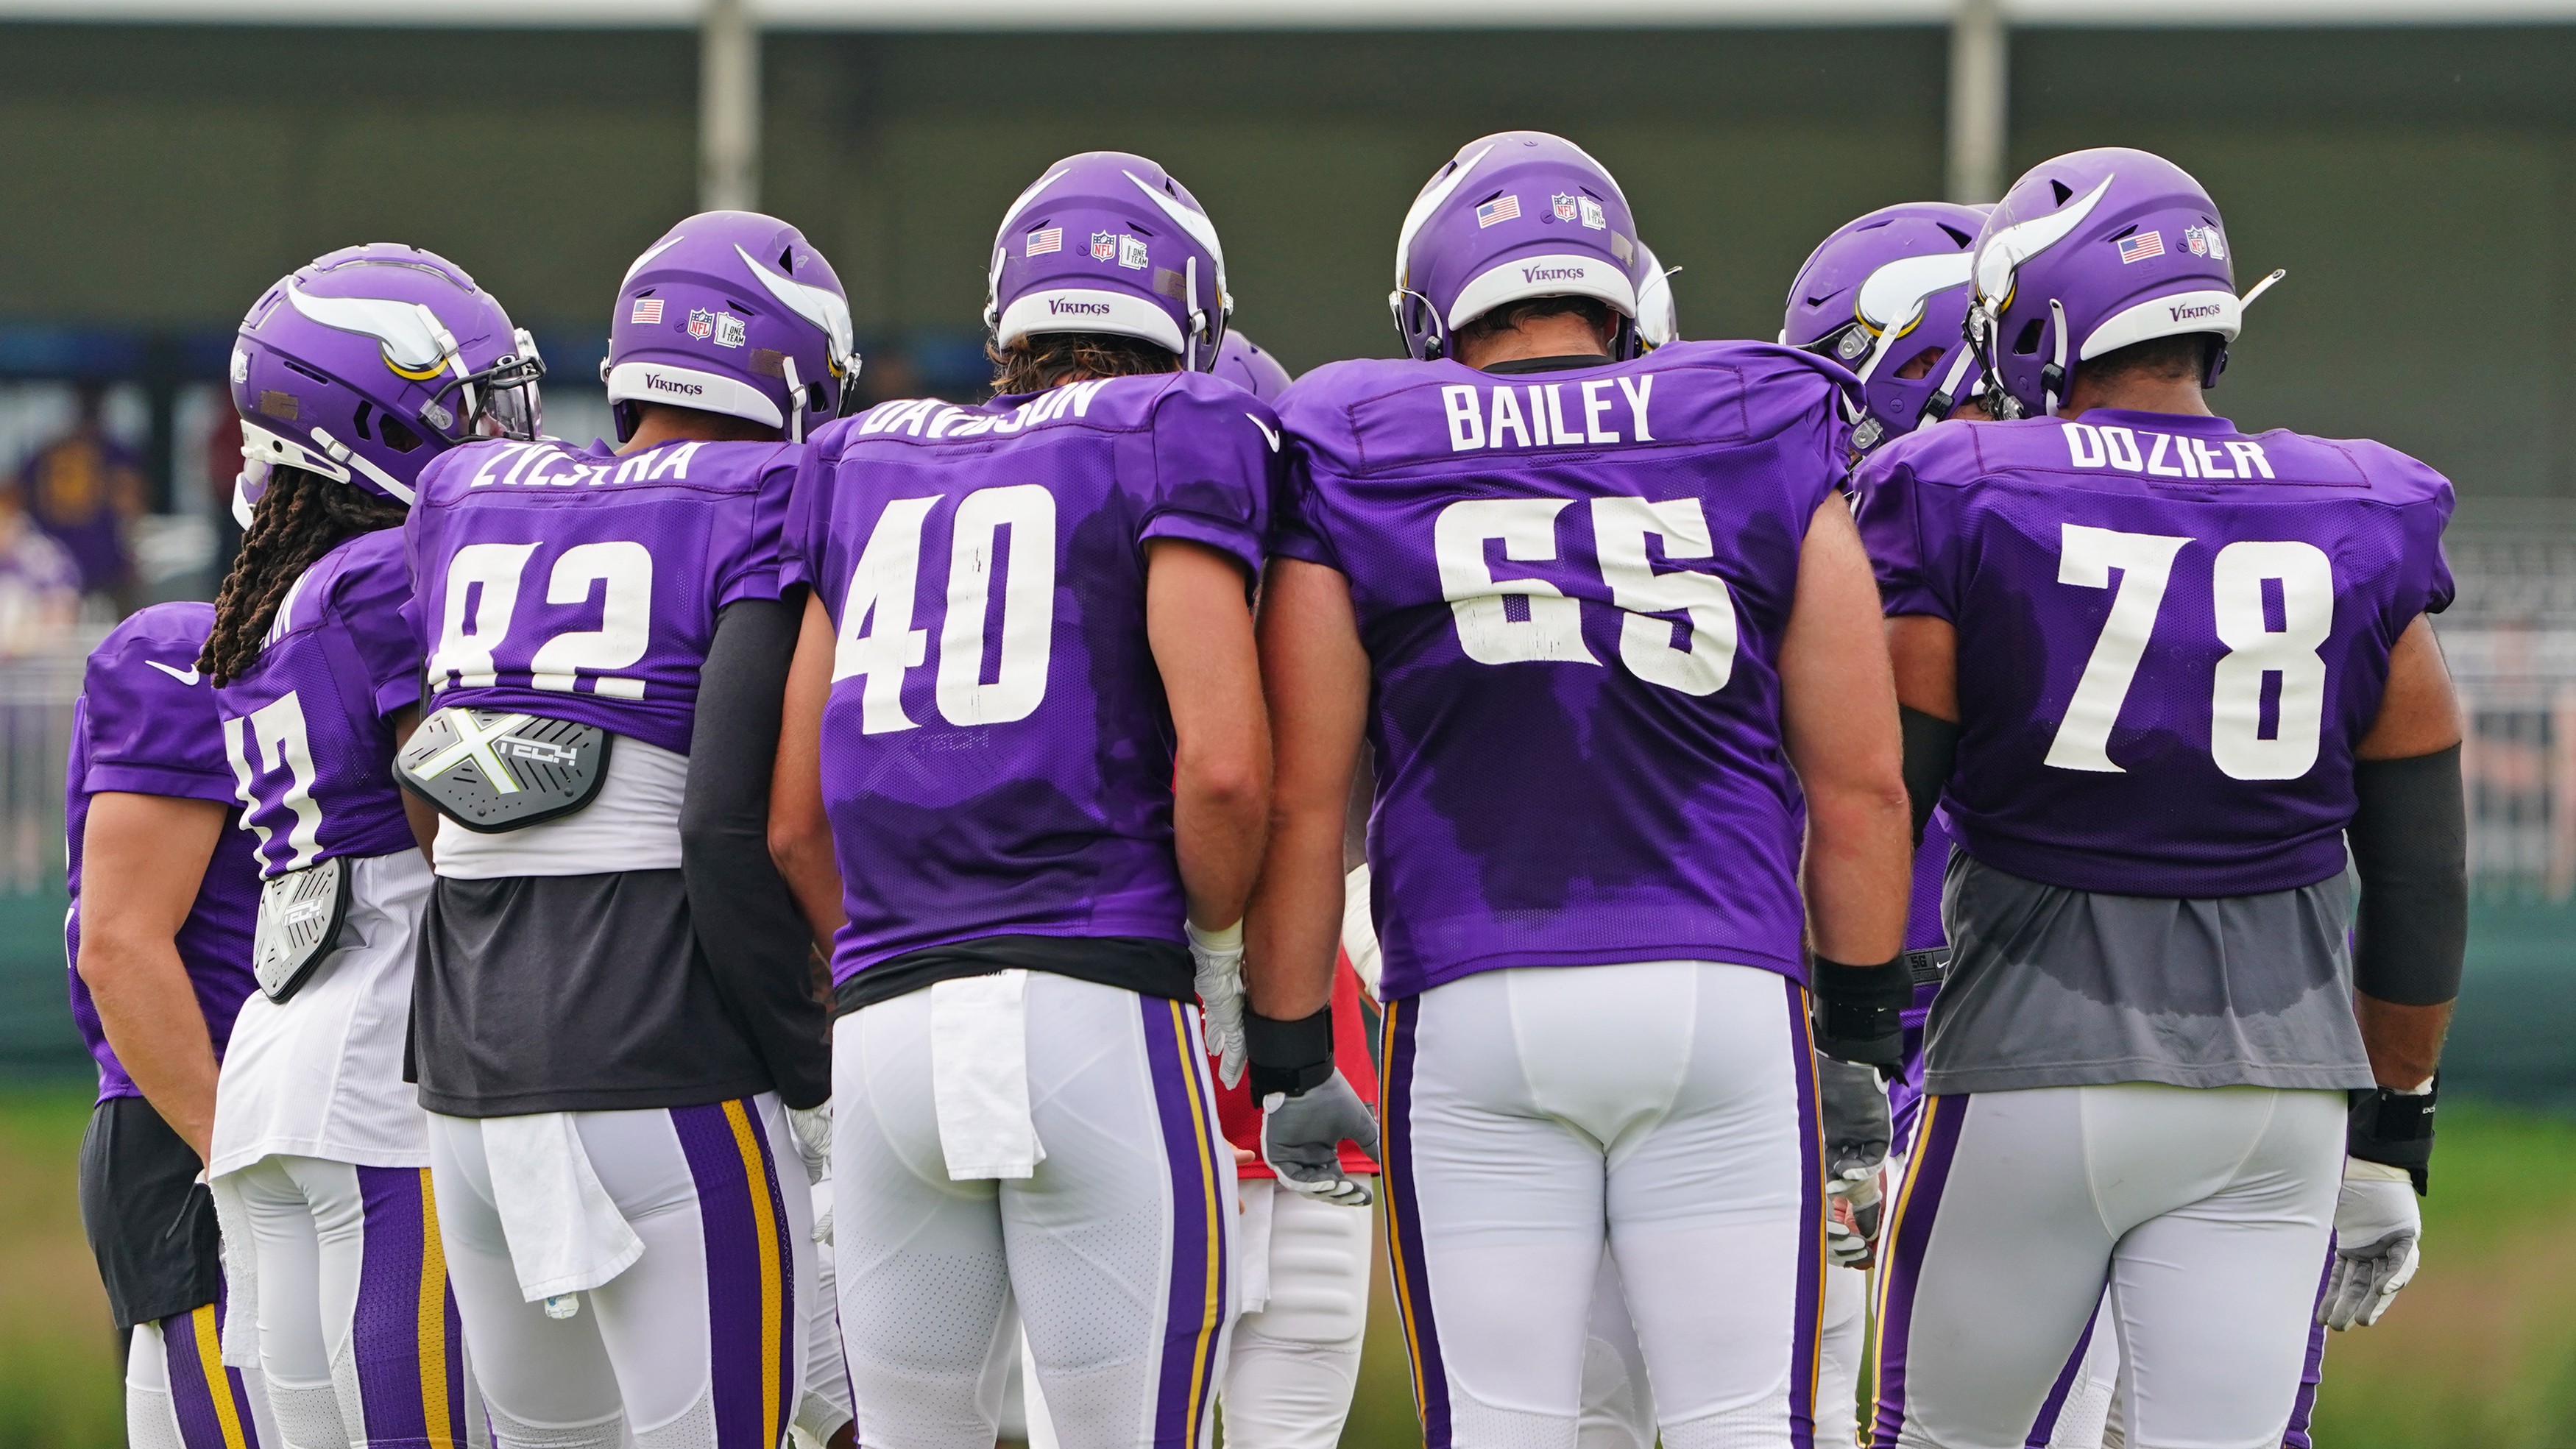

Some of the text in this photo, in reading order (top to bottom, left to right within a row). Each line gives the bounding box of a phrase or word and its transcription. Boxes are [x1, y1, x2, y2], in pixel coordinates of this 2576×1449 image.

[1557, 205, 1574, 217] NFL
[1591, 209, 1602, 219] ONE
[1590, 216, 1605, 227] TEAM
[1094, 244, 1112, 257] NFL
[2190, 239, 2205, 252] NFL
[1133, 247, 1145, 258] ONE
[1130, 255, 1147, 266] TEAM
[691, 322, 709, 335] NFL
[729, 325, 743, 336] ONE
[727, 333, 744, 344] TEAM
[1441, 375, 1656, 452] BAILEY
[2062, 422, 2276, 478] DOZIER
[1434, 496, 1738, 697] 65
[831, 483, 1056, 735] 40
[428, 541, 653, 700] 82
[2044, 522, 2335, 781] 78
